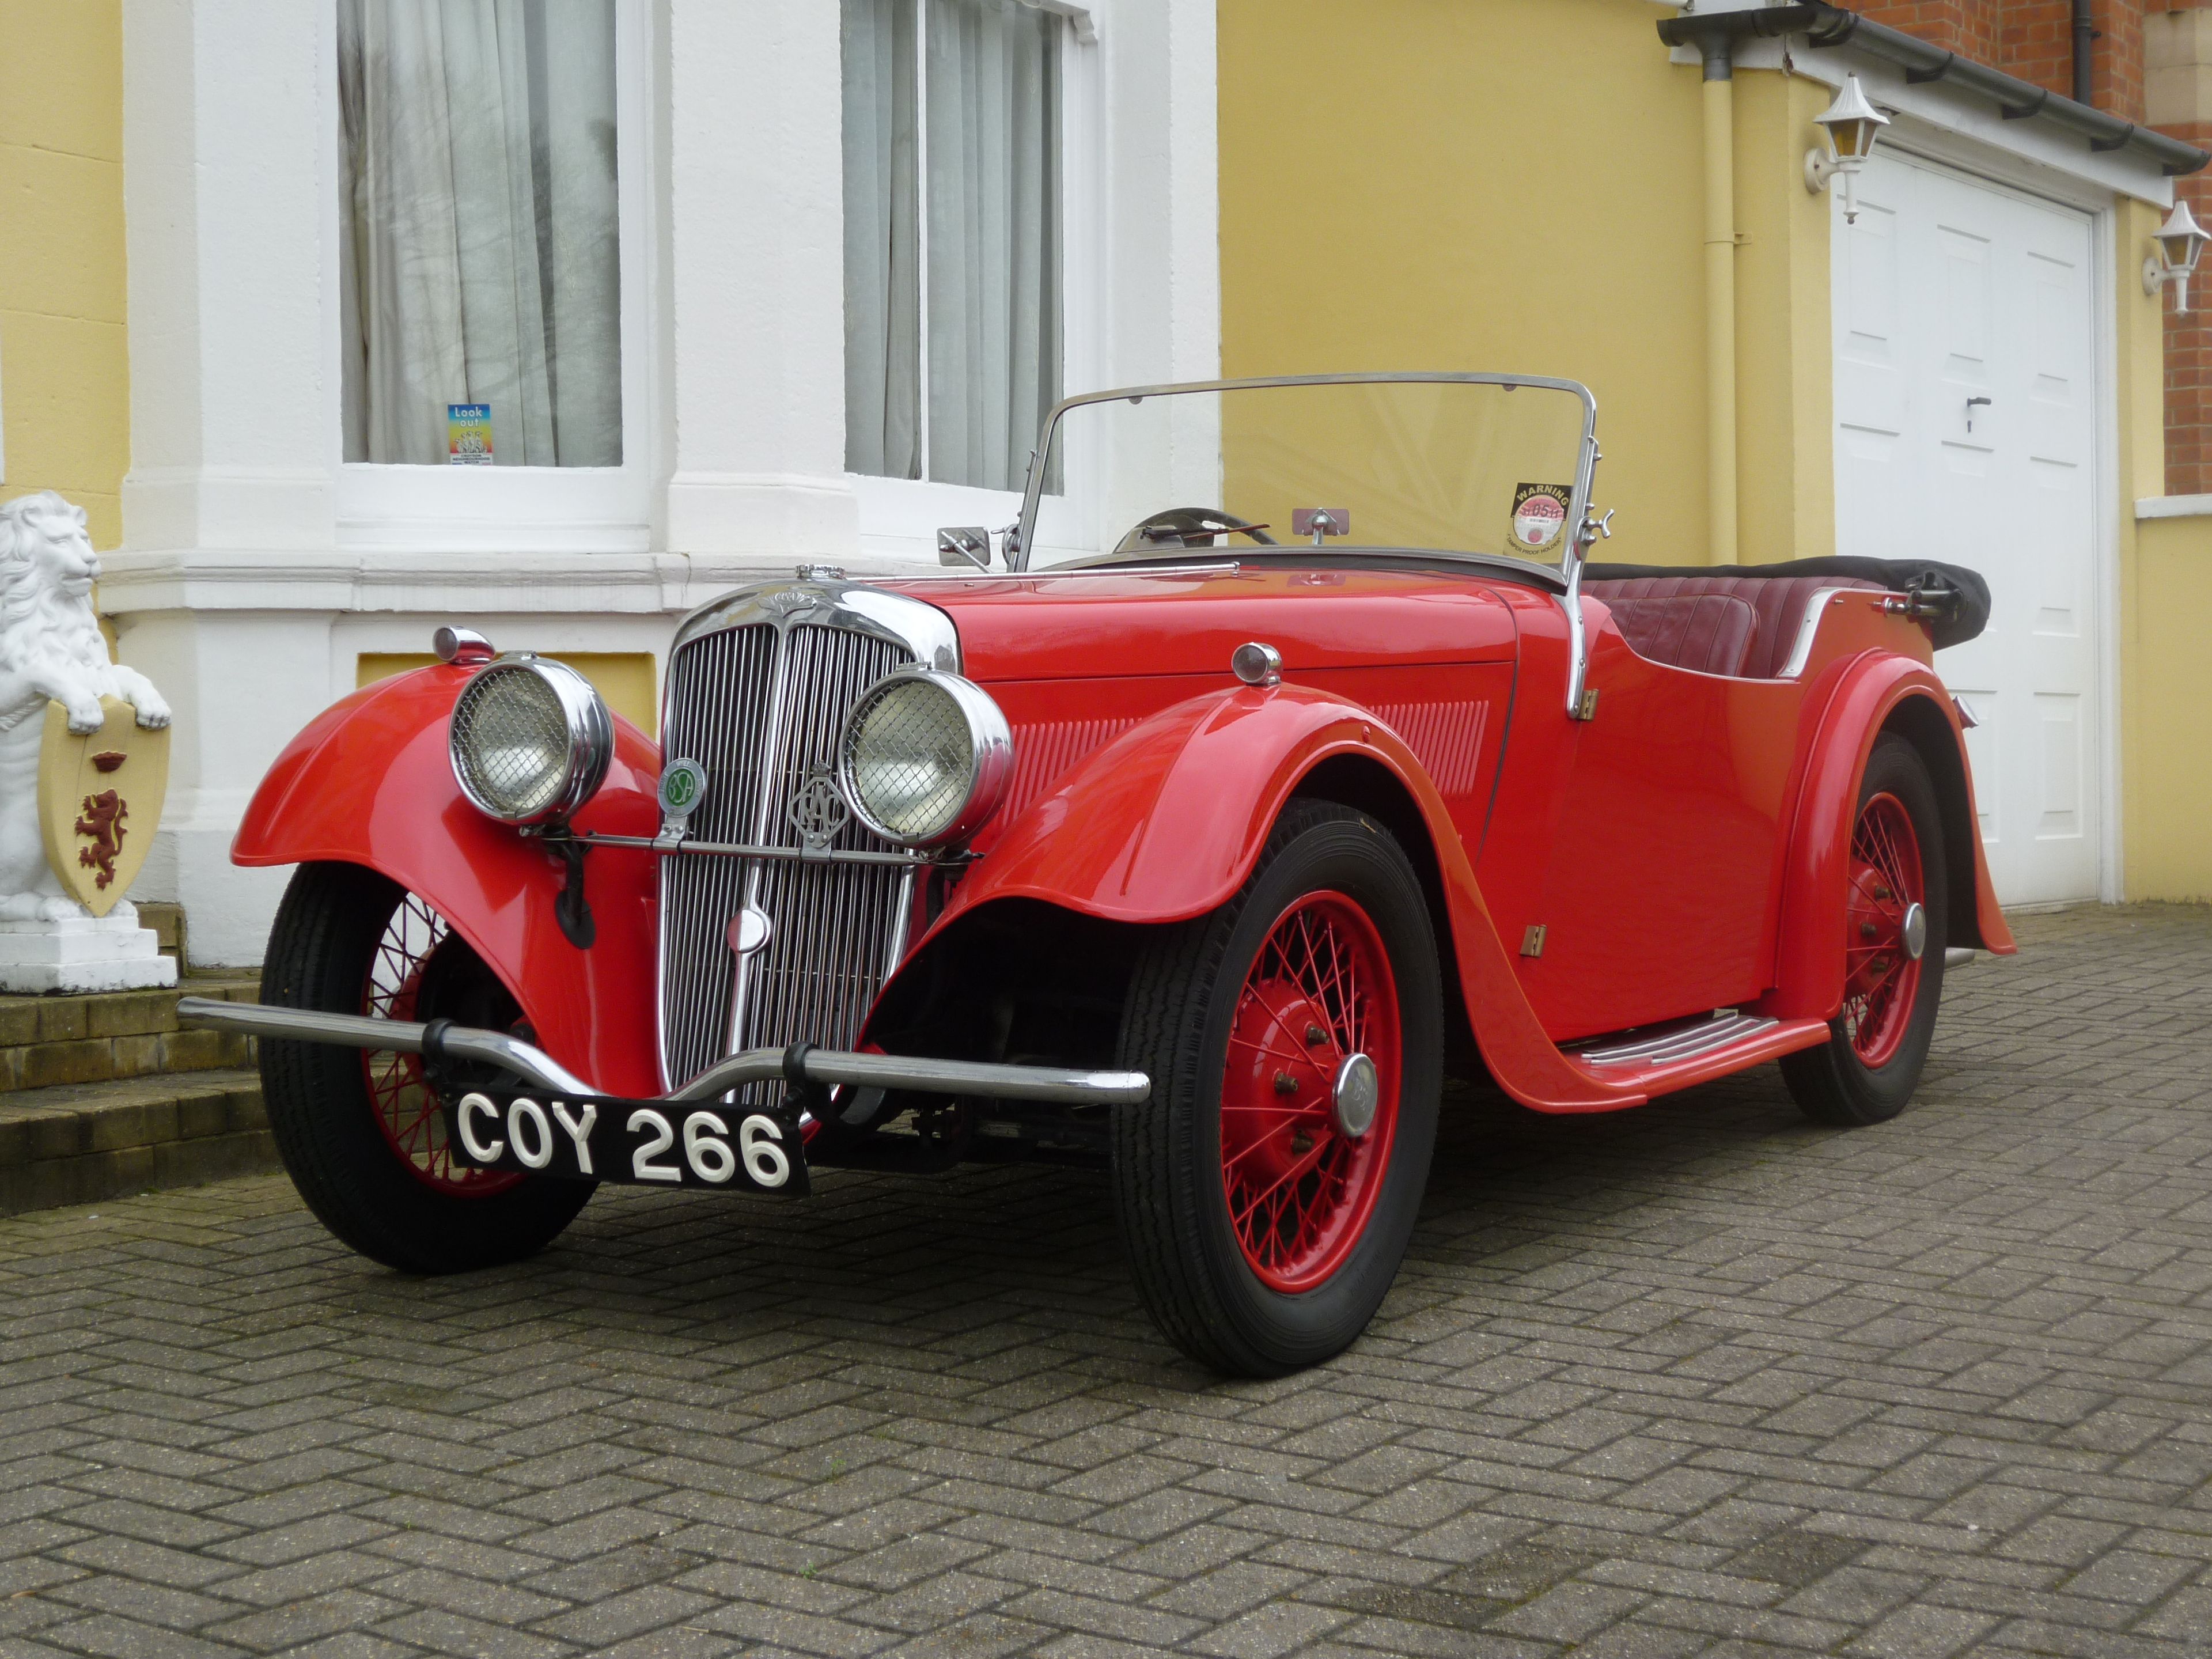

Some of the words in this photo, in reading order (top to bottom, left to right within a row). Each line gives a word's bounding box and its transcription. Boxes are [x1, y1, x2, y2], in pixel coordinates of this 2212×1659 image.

[455, 406, 482, 417] Look
[460, 418, 479, 427] out
[1517, 485, 1569, 506] WARNING
[1532, 504, 1550, 517] 05
[669, 772, 693, 802] BSA
[801, 783, 839, 832] RAC
[458, 1093, 597, 1175] COY
[626, 1109, 789, 1188] 266
